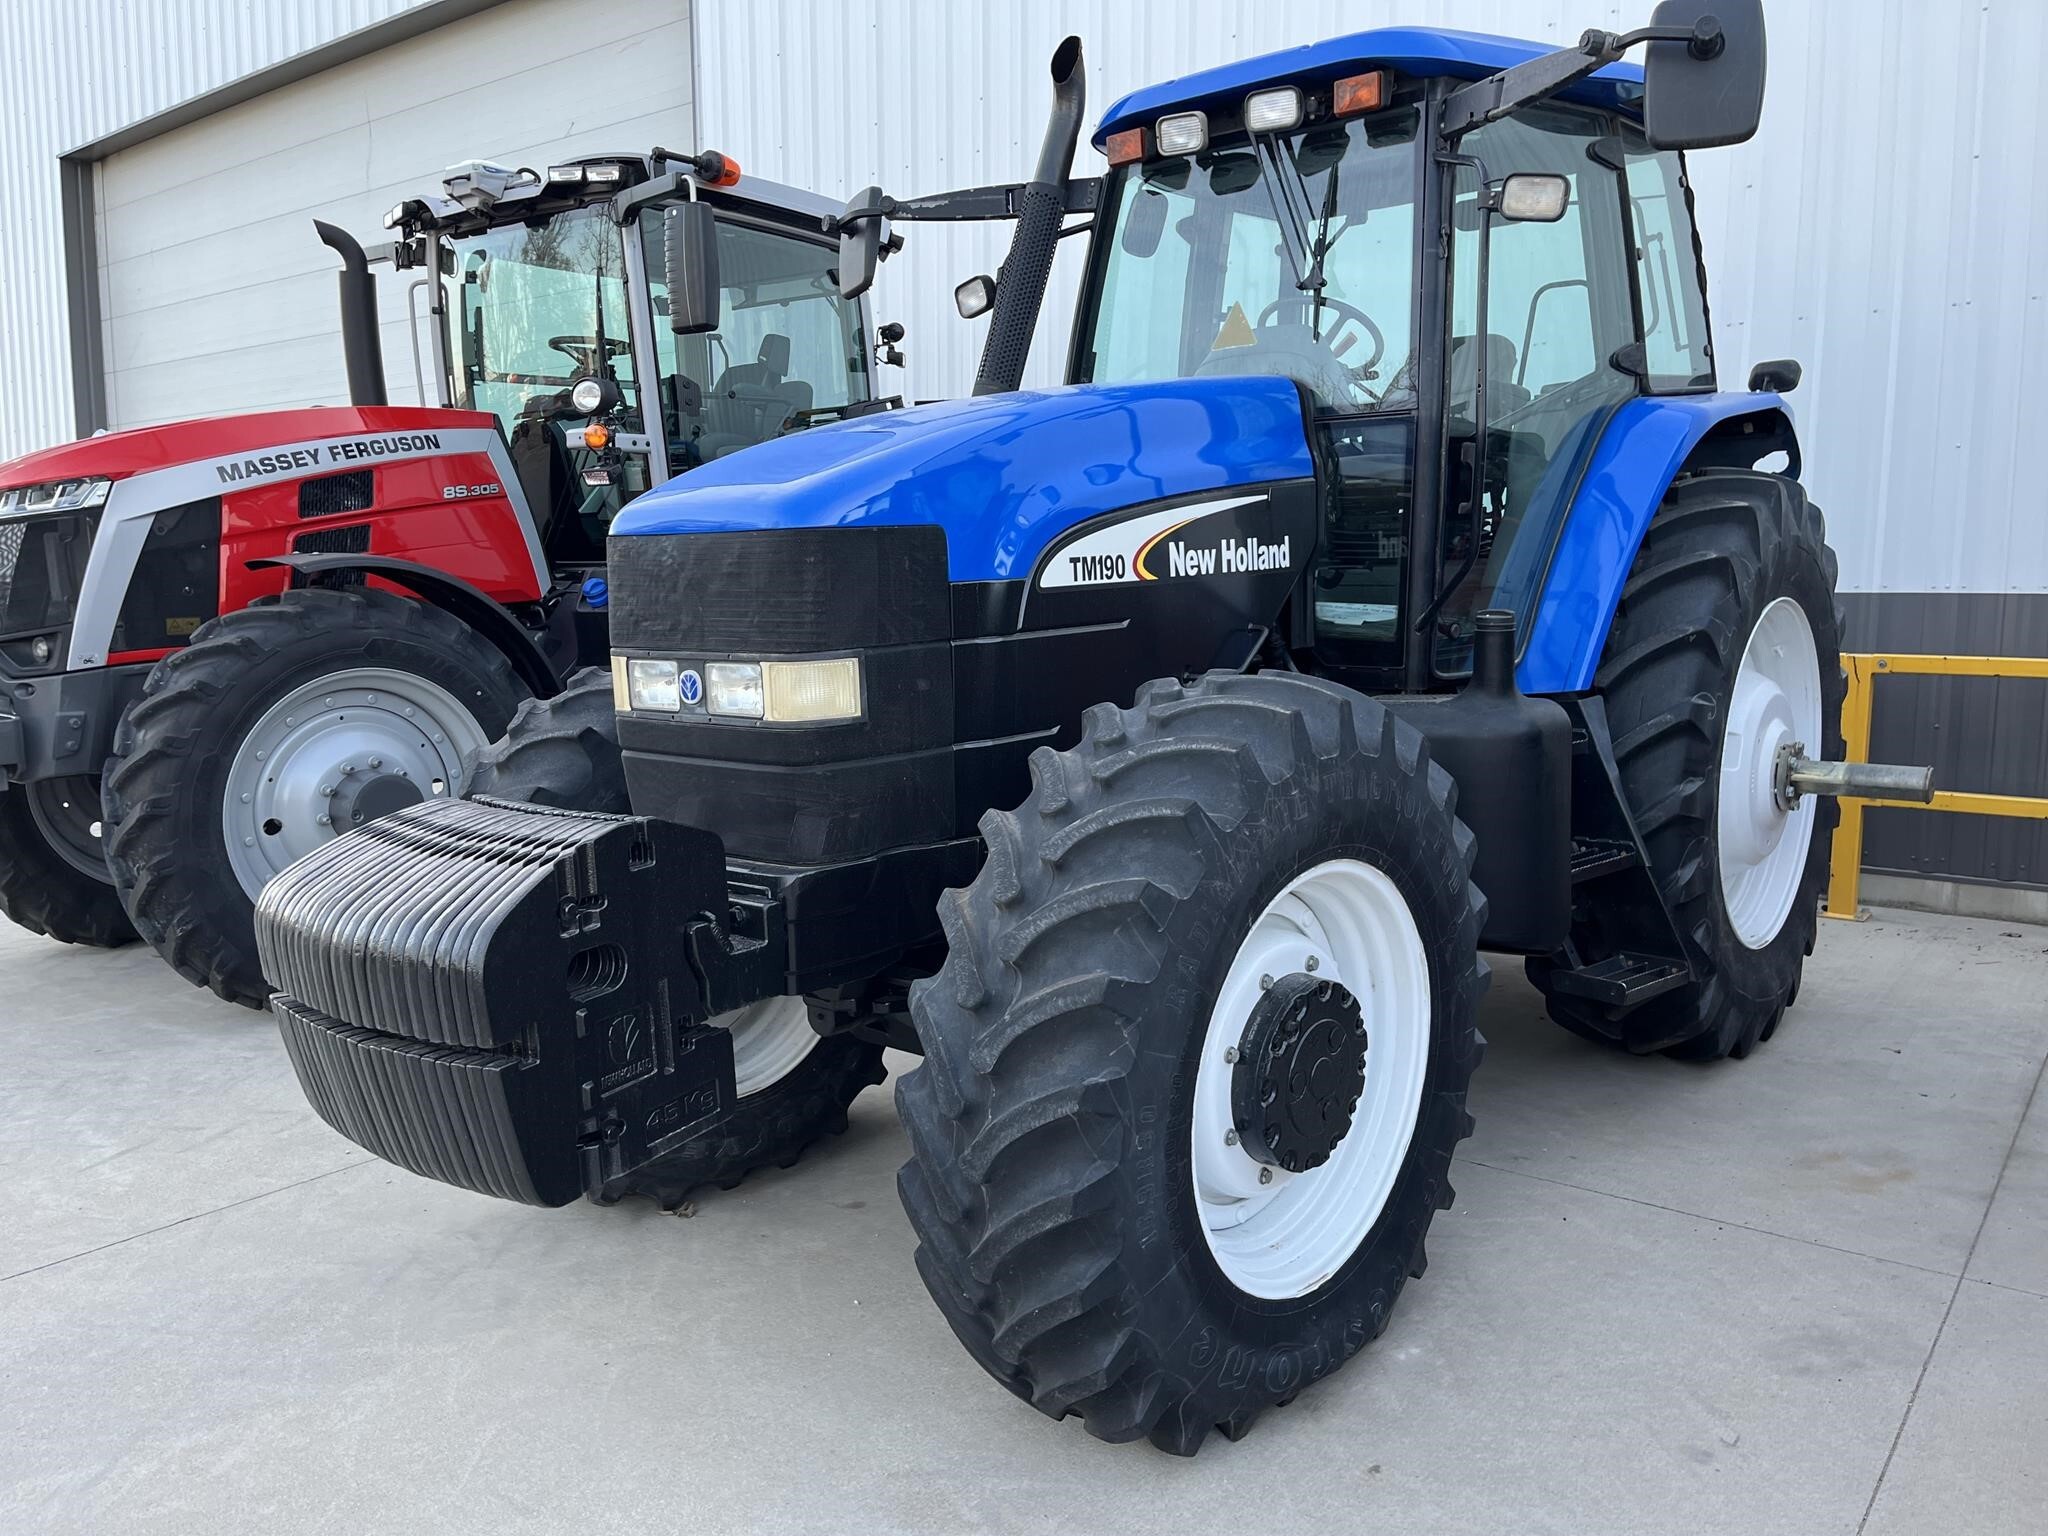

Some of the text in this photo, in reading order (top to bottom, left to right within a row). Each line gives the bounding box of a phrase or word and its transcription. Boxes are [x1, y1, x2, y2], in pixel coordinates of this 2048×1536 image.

[216, 434, 441, 483] MASSEY FERGUSON
[442, 483, 499, 499] 8S.305
[1069, 535, 1291, 582] TM190 New Holland
[646, 1100, 678, 1128] 45
